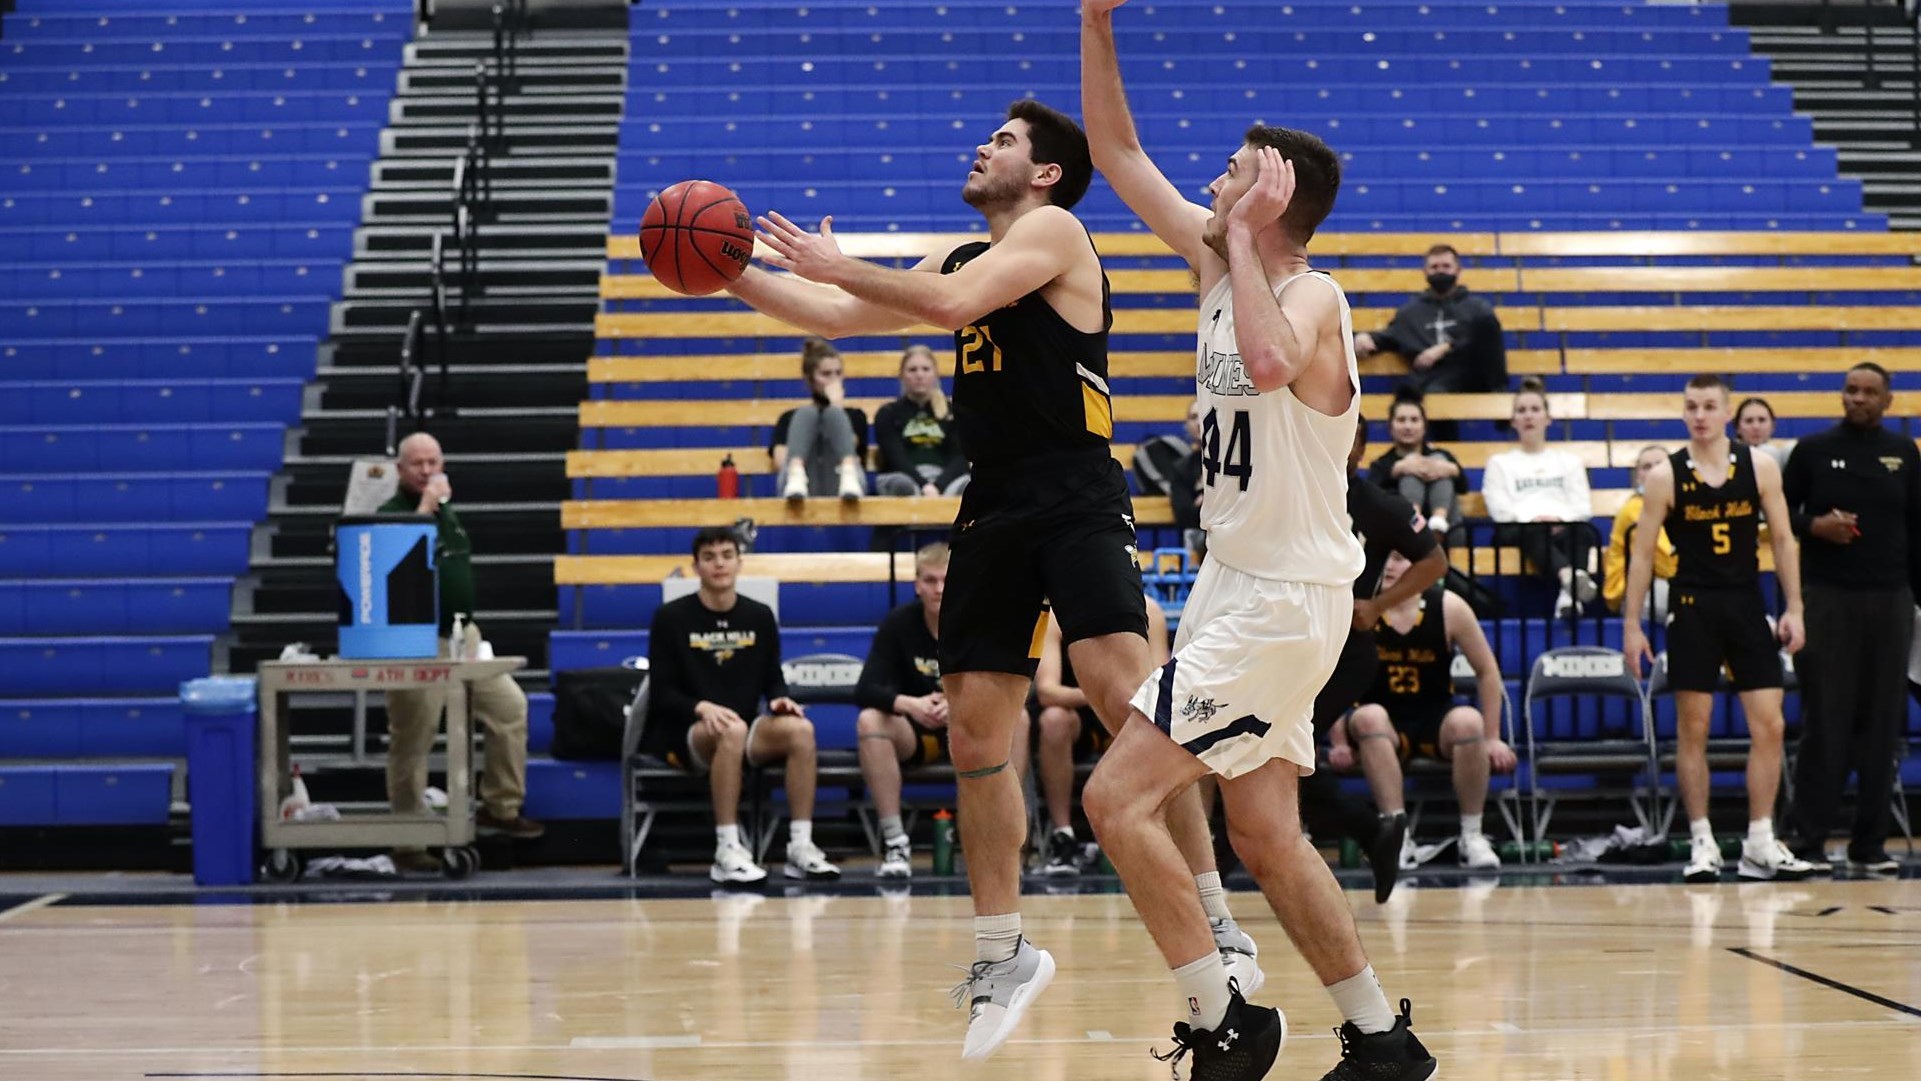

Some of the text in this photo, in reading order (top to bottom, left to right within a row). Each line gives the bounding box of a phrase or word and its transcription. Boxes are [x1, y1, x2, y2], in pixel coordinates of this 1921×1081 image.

[961, 325, 1002, 374] 21
[1202, 406, 1253, 492] 44
[1711, 523, 1731, 554] 5
